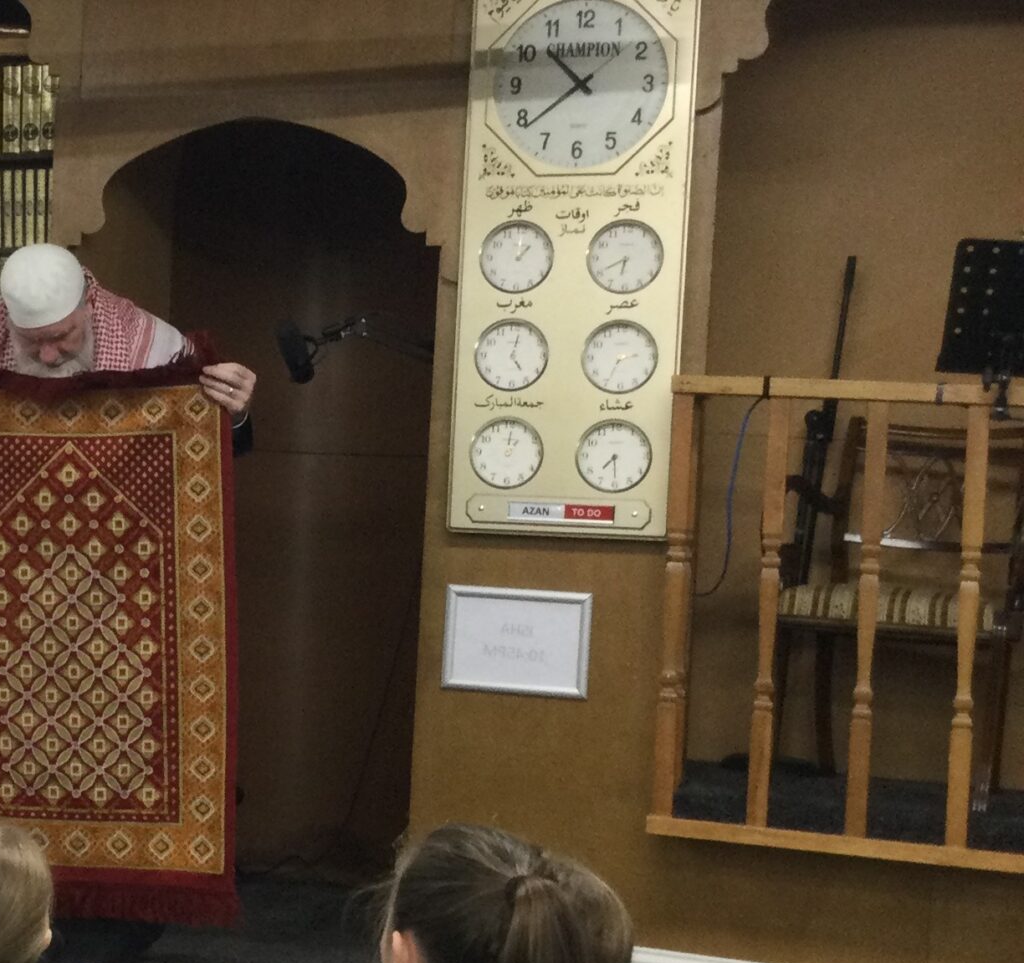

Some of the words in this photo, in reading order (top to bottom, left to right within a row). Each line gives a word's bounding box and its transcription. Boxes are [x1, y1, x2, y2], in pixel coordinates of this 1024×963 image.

[575, 9, 595, 28] 12
[614, 18, 623, 36] 1
[545, 19, 560, 38] 11
[516, 44, 536, 63] 10
[547, 41, 622, 59] CHAMPION
[634, 42, 649, 61] 2
[510, 76, 522, 95] 9
[642, 74, 655, 93] 3
[516, 109, 528, 127] 8
[631, 108, 643, 126] 4
[539, 132, 551, 151] 7
[571, 141, 582, 160] 6
[604, 132, 617, 150] 5
[522, 506, 550, 516] AZAN
[571, 508, 585, 517] TO
[587, 509, 601, 517] DO
